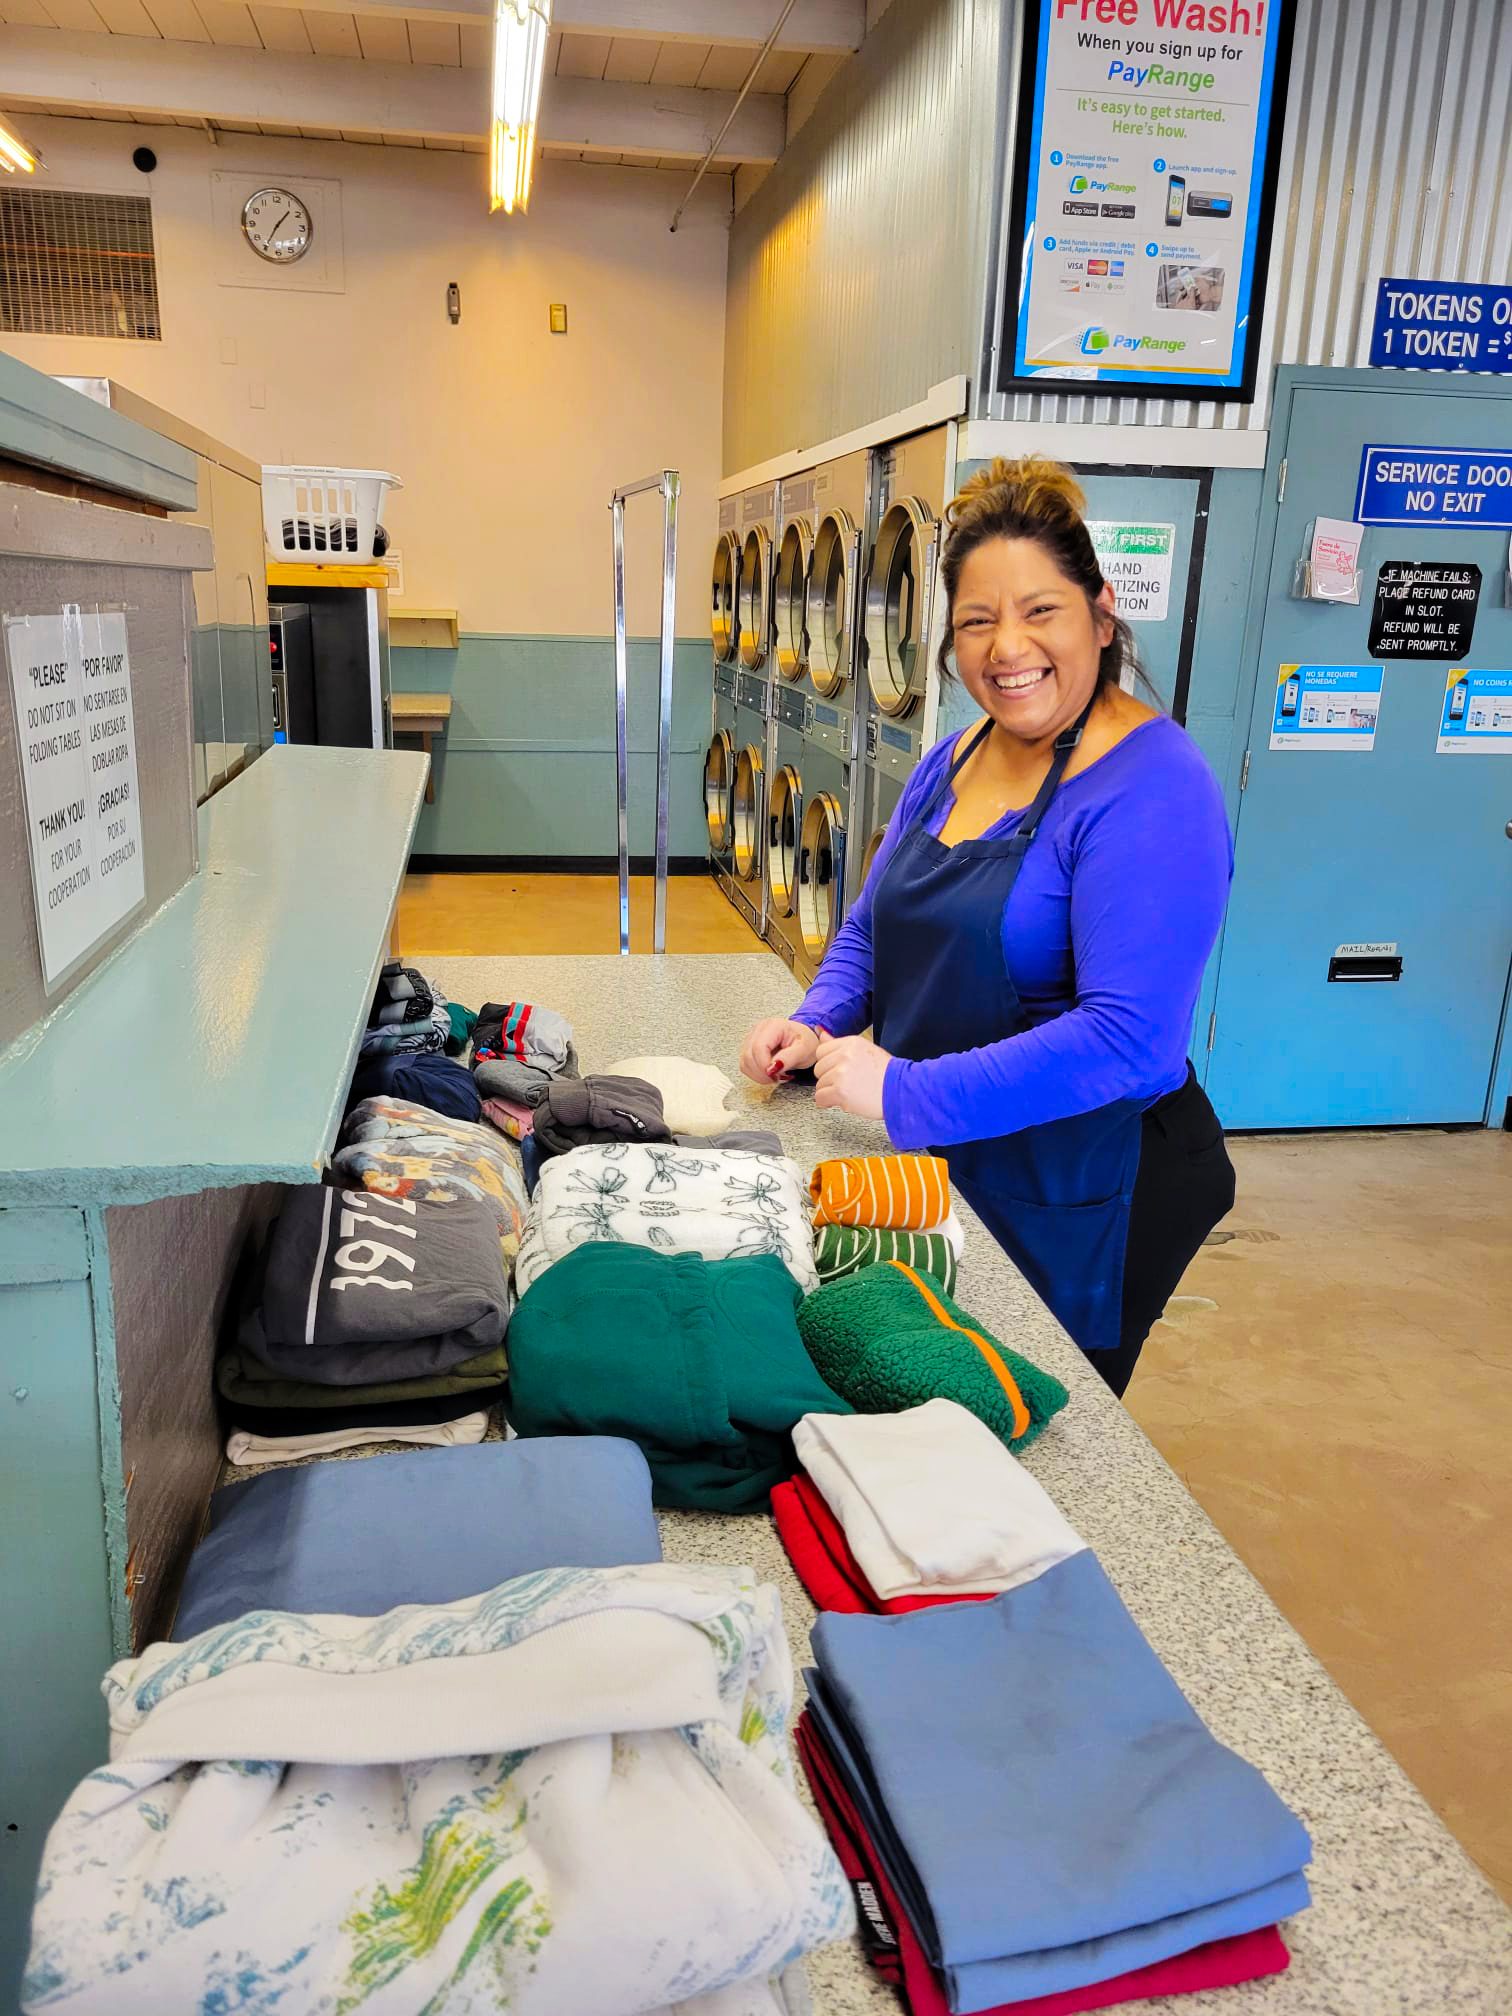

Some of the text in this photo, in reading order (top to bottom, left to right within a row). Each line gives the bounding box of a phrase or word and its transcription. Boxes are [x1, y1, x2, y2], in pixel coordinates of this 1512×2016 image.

[1056, 0, 1264, 36] Free Wash!
[1077, 32, 1243, 61] When you sign up for
[1108, 60, 1215, 92] PayRange
[1077, 98, 1226, 122] It's easy to get started.
[1112, 120, 1188, 139] Here's how.
[1066, 153, 1119, 163] Download the free
[1089, 180, 1137, 193] PayRange
[1071, 207, 1097, 215] App Store
[1067, 262, 1084, 270] VISA
[1386, 292, 1512, 325] TOKENS O
[1113, 334, 1186, 353] PayRange
[1383, 329, 1393, 353] 1
[1402, 329, 1479, 358] TOKEN
[1375, 461, 1512, 487] SERVICE DOO
[1405, 490, 1486, 513] NO EXIT
[1119, 533, 1167, 546] FIRST
[1102, 562, 1142, 575] HAND
[1388, 569, 1471, 583] IF MACHINE FAILS:
[1112, 580, 1161, 593] TIZING
[1412, 587, 1448, 599] REFUND
[1451, 589, 1476, 600] CARD
[1115, 597, 1149, 610] TION
[1405, 604, 1444, 617] IN SLOT.
[1383, 621, 1461, 635] REFUND WILL BE
[1380, 639, 1458, 651] SENT PROMPTLY.
[1326, 671, 1359, 679] REQUIERE
[1486, 679, 1508, 687] COINS
[83, 687, 128, 712] NO SENTARSE EN
[28, 699, 77, 729] DO NOT SIT ON
[90, 715, 127, 742] LAS MESAS DE
[29, 729, 81, 766] FOLDING TABLES
[92, 743, 129, 772] DOBLAR ROPA
[39, 798, 86, 841] THANK YOU!
[107, 817, 126, 843] POR SU
[51, 839, 82, 872] FOR YOUR
[48, 865, 91, 910] COOPERATION
[330, 1190, 418, 1291] 1972
